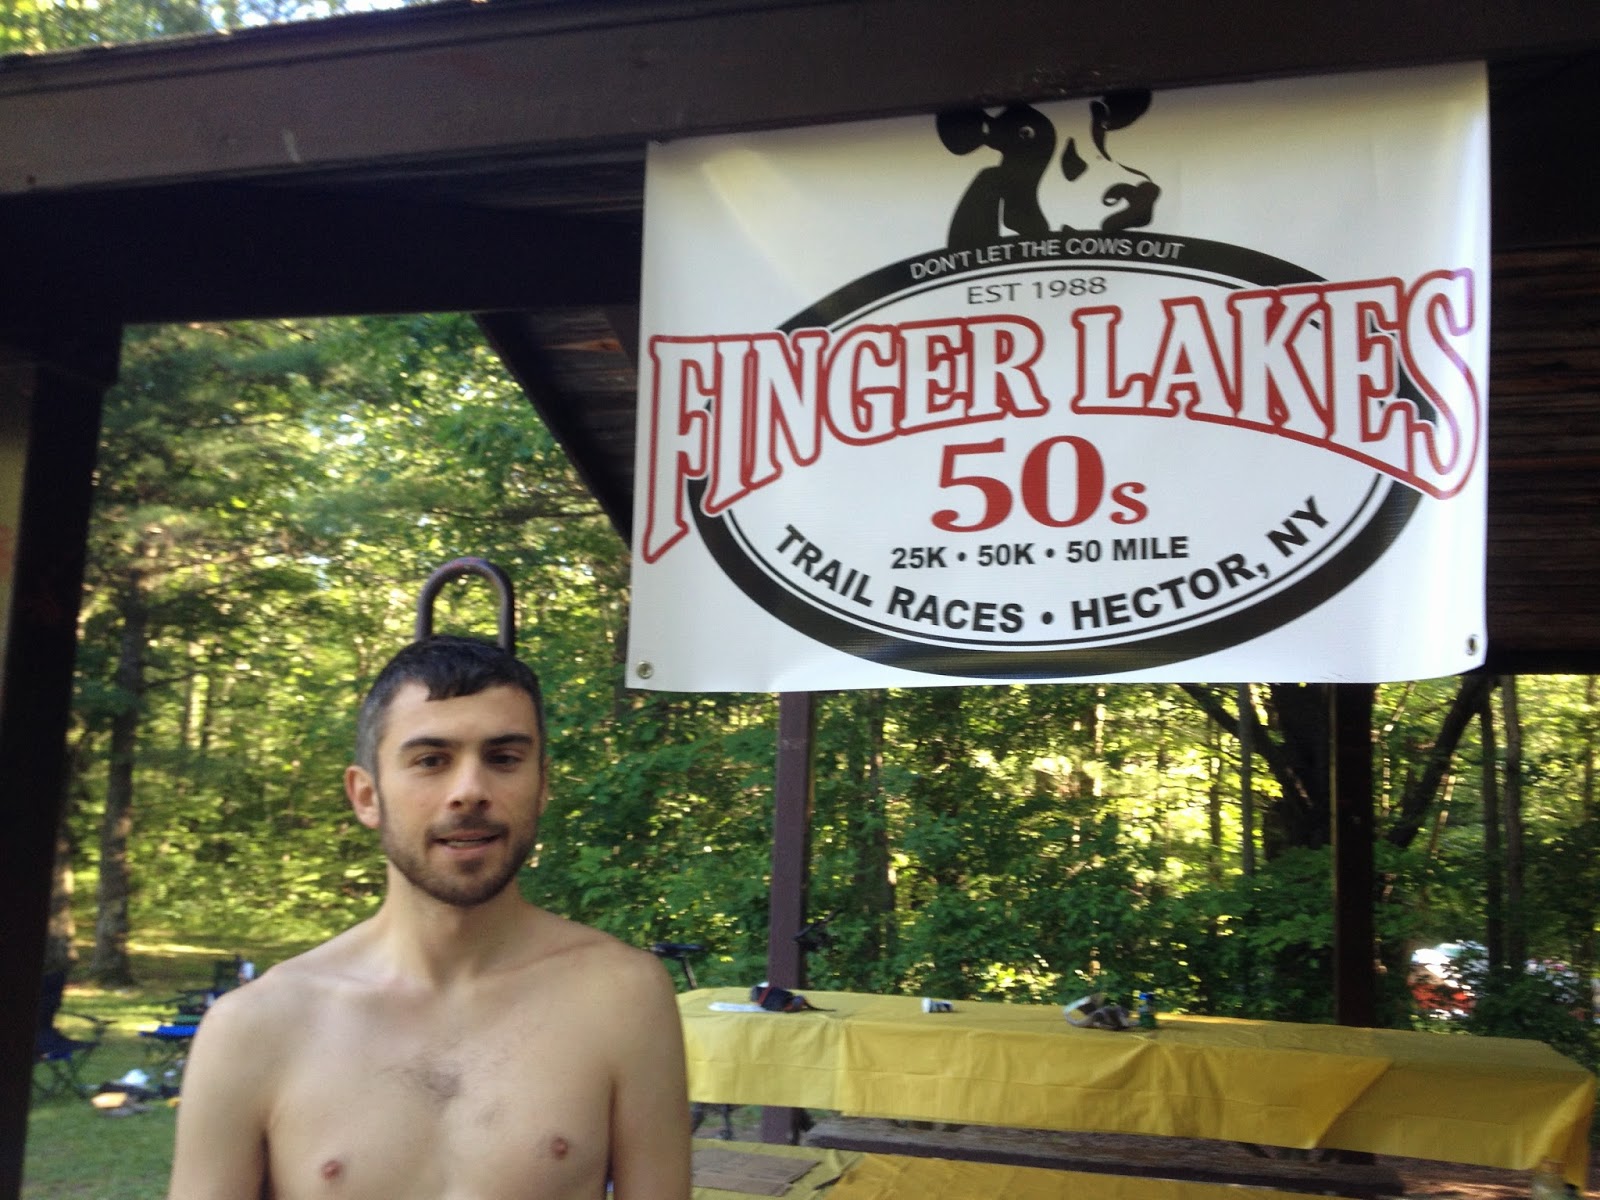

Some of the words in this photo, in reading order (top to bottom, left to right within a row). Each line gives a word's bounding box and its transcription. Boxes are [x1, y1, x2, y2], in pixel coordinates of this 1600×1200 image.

[909, 250, 972, 279] DON'T
[976, 243, 1016, 265] LET
[1018, 239, 1062, 257] THE
[1065, 237, 1133, 256] COWS
[1136, 239, 1185, 260] OUT
[967, 282, 1021, 304] EST
[1033, 276, 1108, 299] 1988
[642, 314, 1051, 564] FINGER
[1071, 267, 1480, 500] LAKES
[931, 435, 1149, 532] 50s
[775, 523, 874, 607] TRAIL
[886, 585, 1024, 634] RACES
[1070, 553, 1271, 630] HECTOR,
[1265, 495, 1329, 558] NY
[890, 546, 948, 569] 25K
[977, 543, 1036, 567] 50K
[1066, 539, 1102, 563] 50
[1112, 535, 1189, 561] MILE
